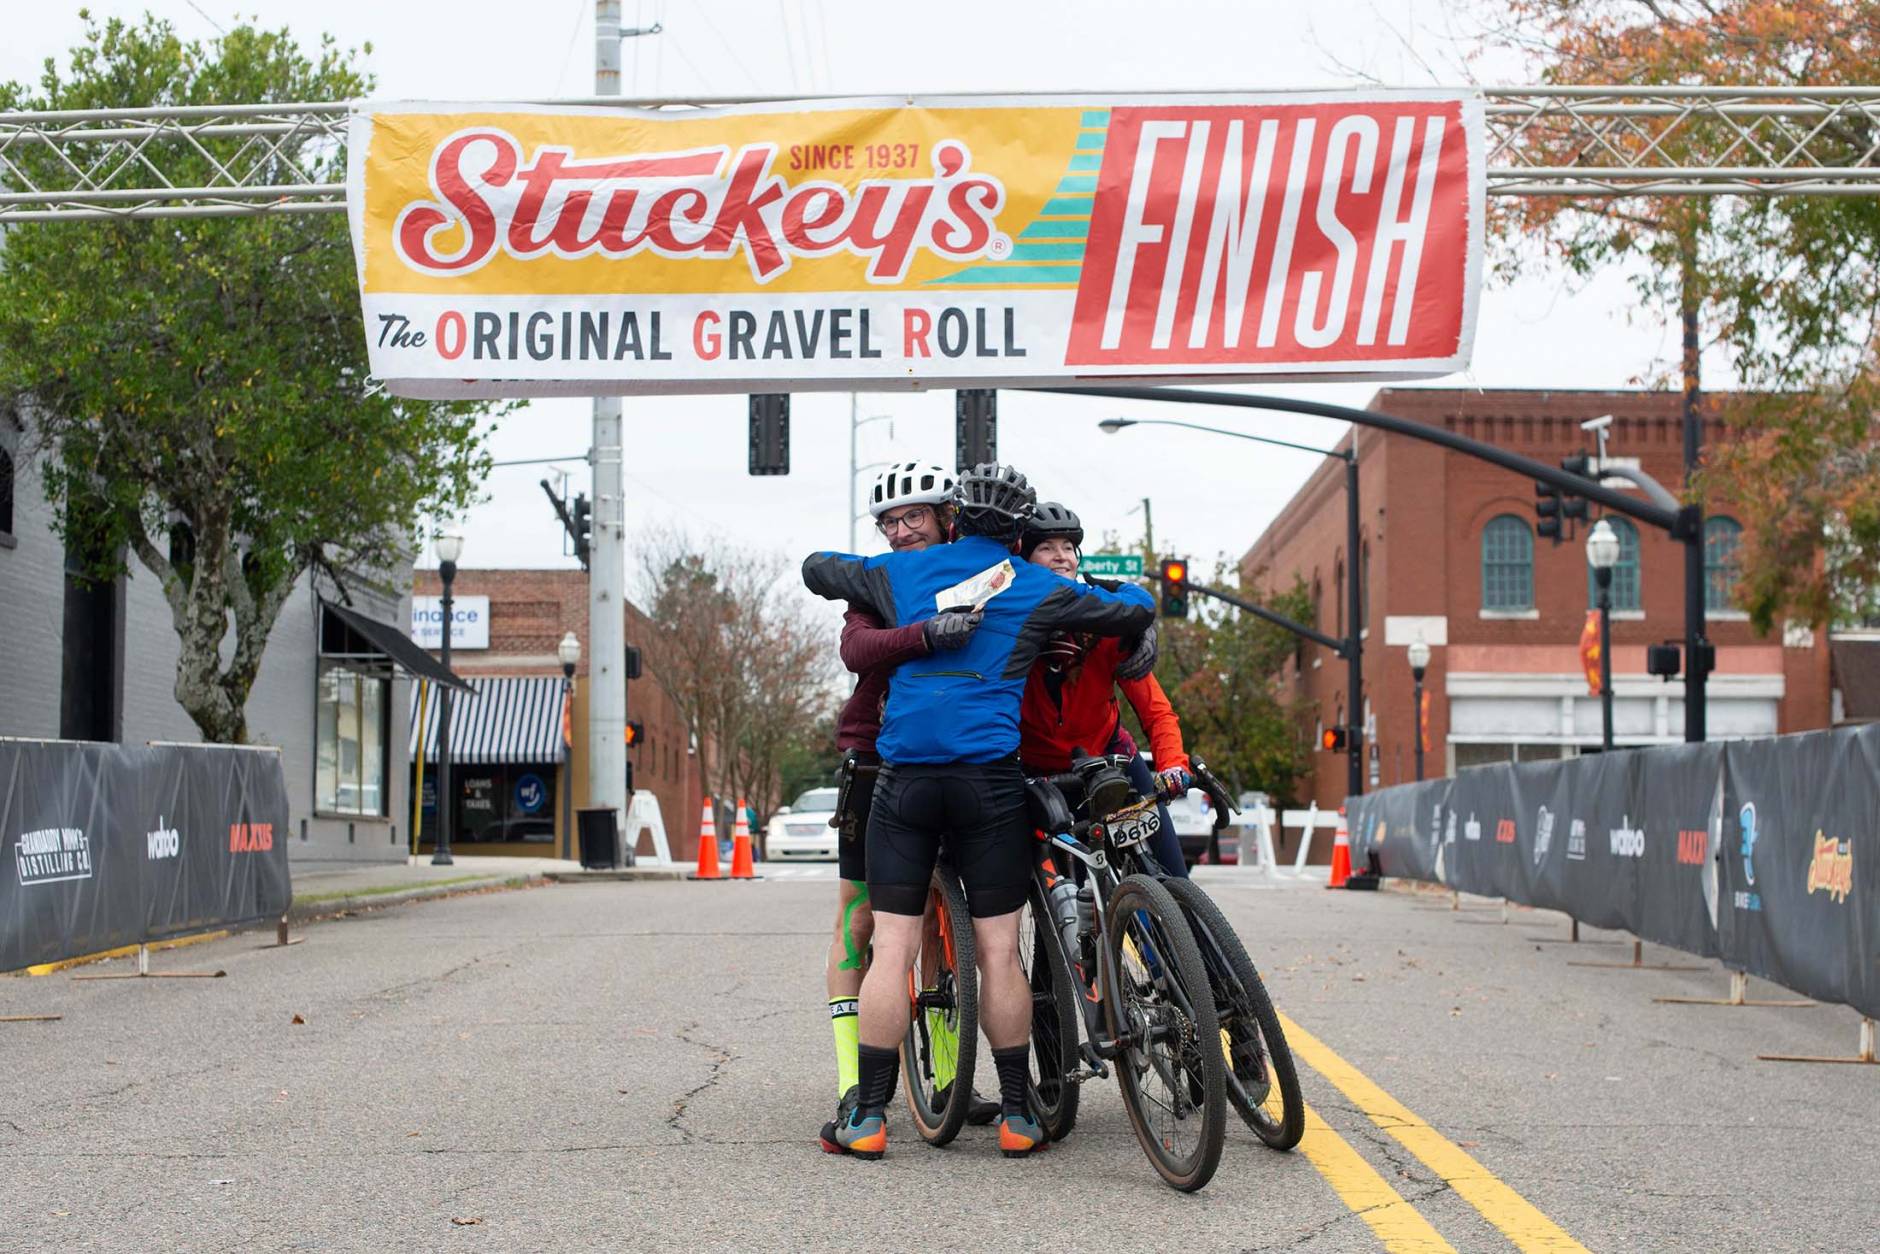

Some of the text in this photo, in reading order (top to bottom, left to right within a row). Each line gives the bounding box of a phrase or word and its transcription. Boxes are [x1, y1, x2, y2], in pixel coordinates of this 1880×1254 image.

[396, 131, 1000, 281] Stuckey's
[790, 144, 919, 170] SINCE 1937
[1101, 115, 1446, 350] FINISH
[377, 306, 1027, 361] The ORIGINAL GRAVEL ROLL
